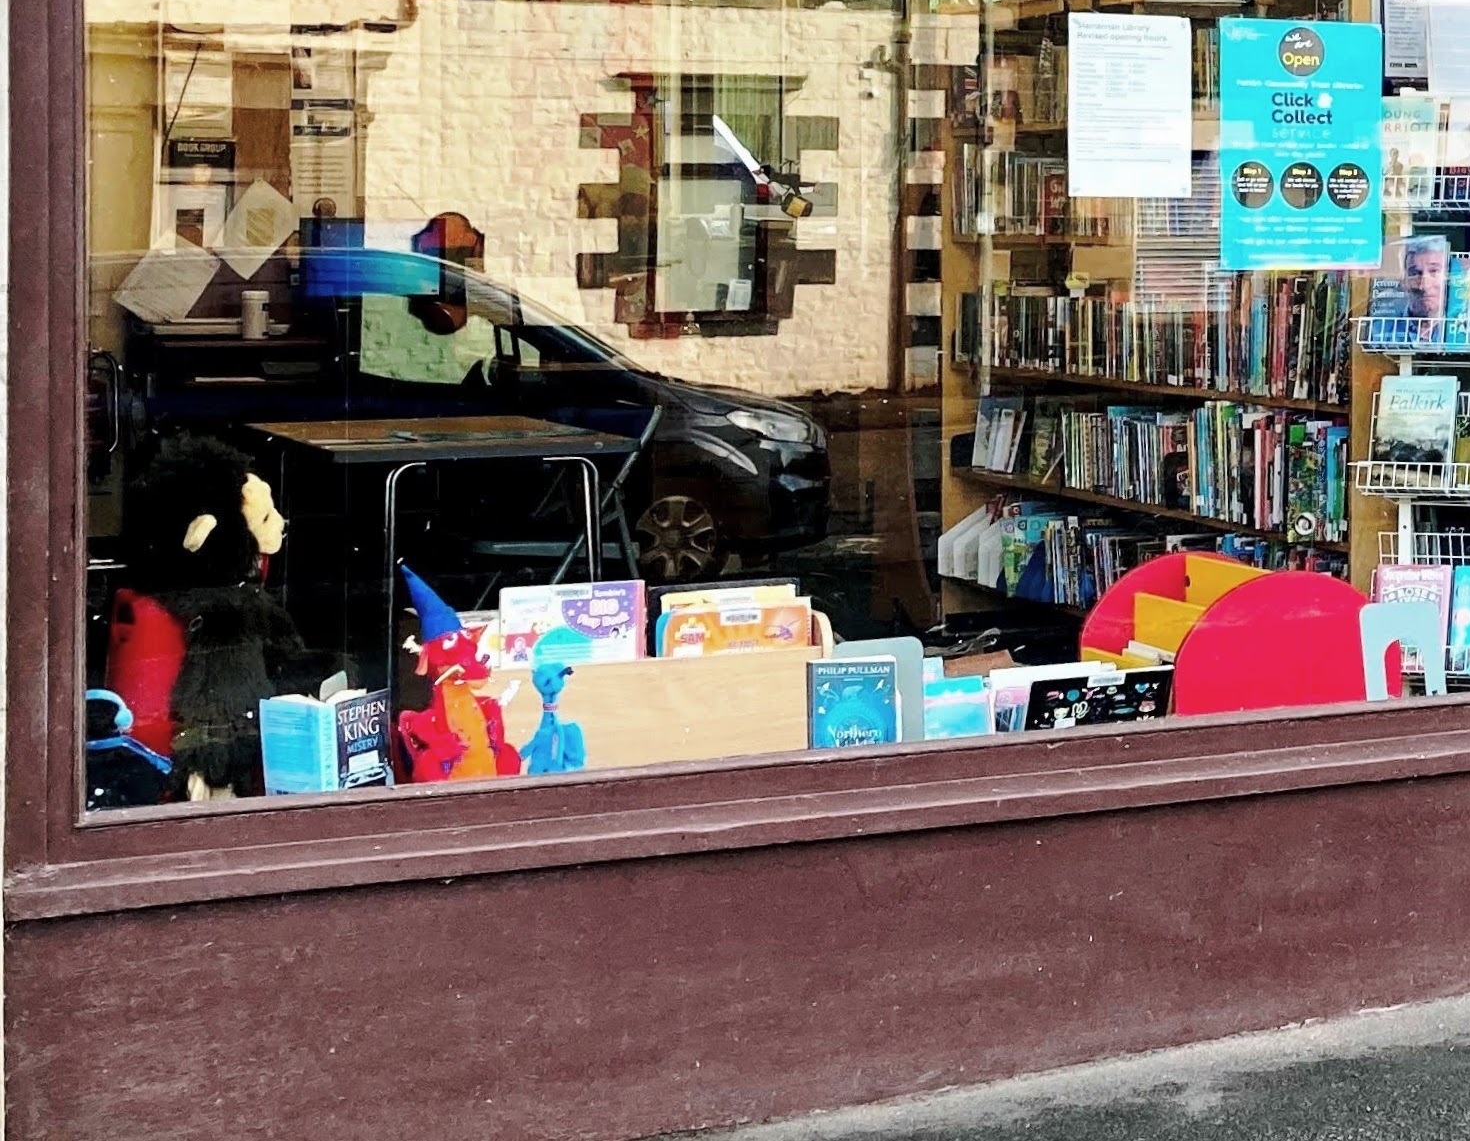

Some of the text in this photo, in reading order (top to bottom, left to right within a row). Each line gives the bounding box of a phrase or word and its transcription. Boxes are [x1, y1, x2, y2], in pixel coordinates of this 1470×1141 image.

[1294, 39, 1313, 49] are
[1282, 52, 1320, 67] Open
[1271, 92, 1314, 107] Click
[1271, 109, 1333, 125] Collect
[1372, 278, 1400, 288] Jeremy
[1389, 394, 1447, 411] Falkirk
[818, 665, 890, 675] PHILIP PULLMAN
[337, 699, 386, 725] STEPHEN
[344, 716, 380, 742] KING
[346, 736, 378, 754] MISERY
